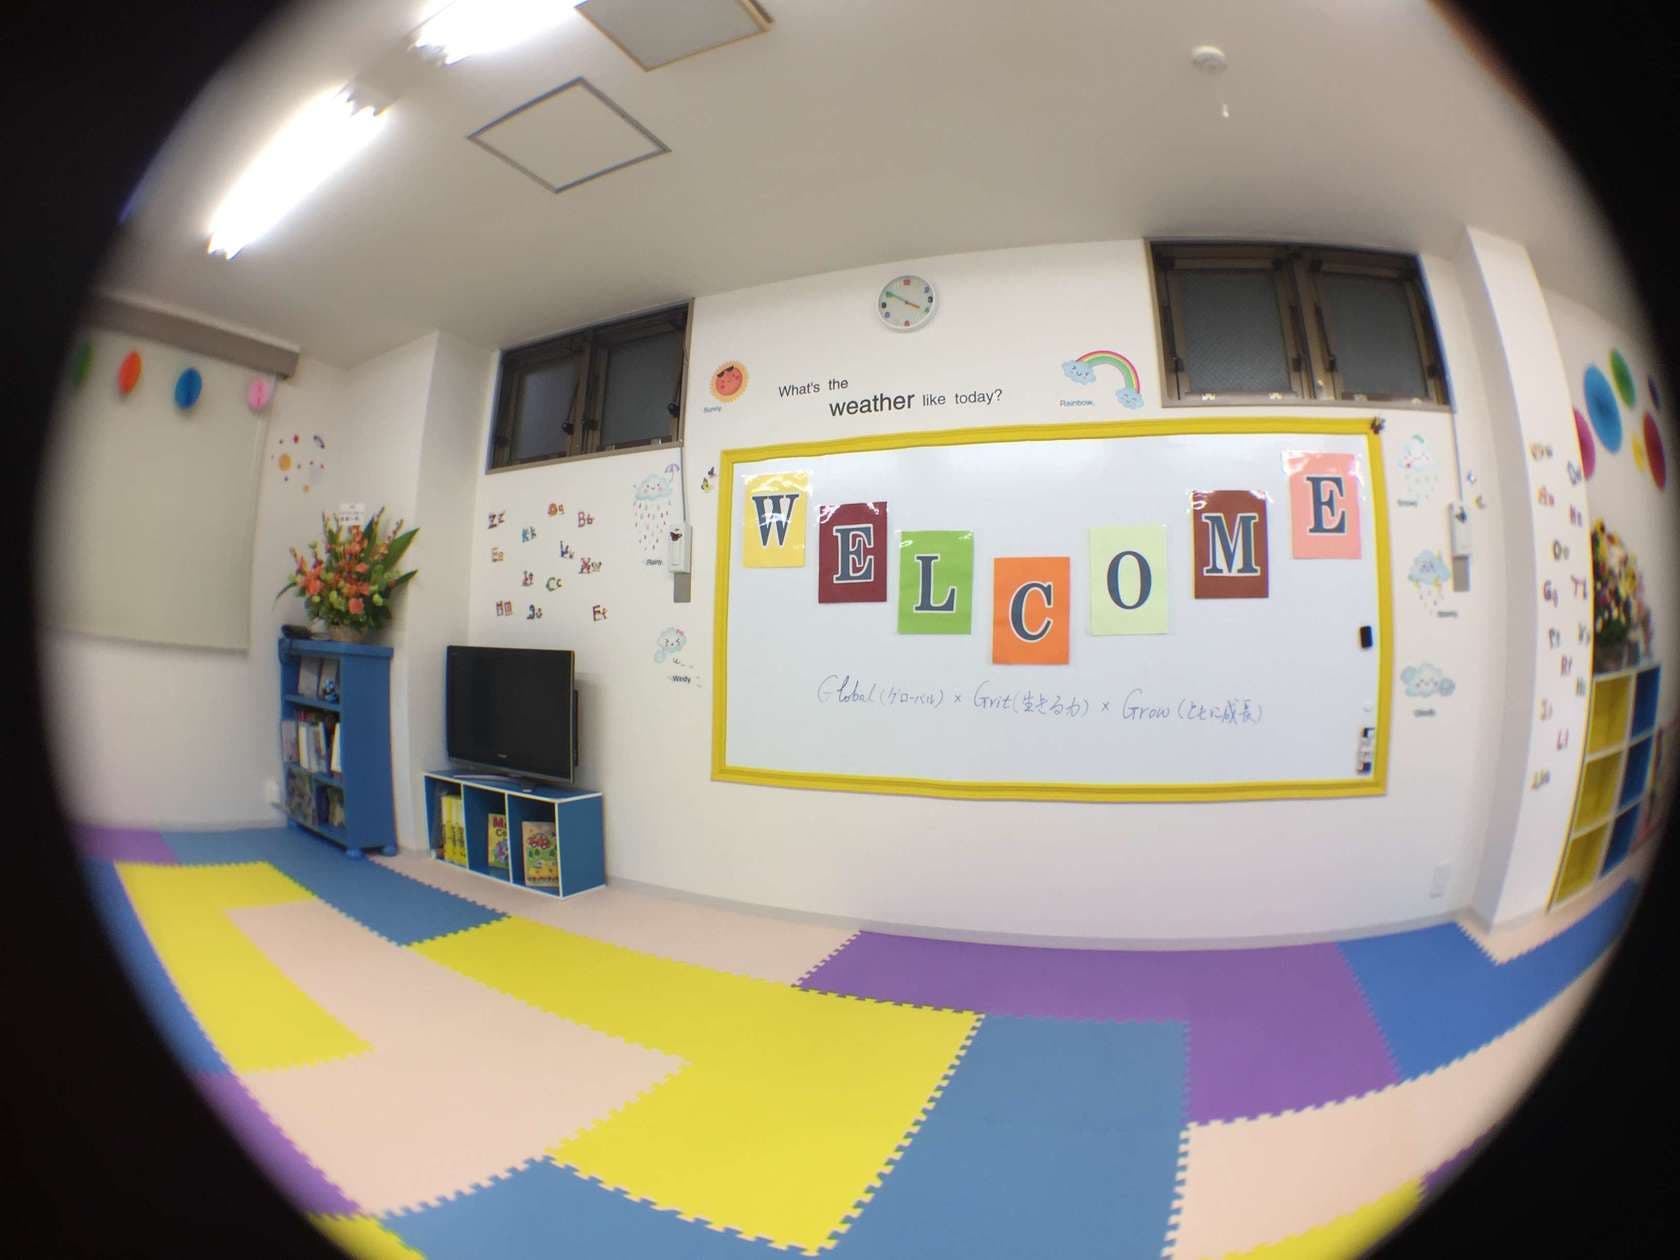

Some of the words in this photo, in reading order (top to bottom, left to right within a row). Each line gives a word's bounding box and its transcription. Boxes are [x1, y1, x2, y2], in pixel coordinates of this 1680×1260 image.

[779, 382, 820, 398] What's
[828, 378, 849, 391] the
[829, 393, 915, 417] weather
[922, 394, 947, 406] like
[955, 388, 1003, 405] today?
